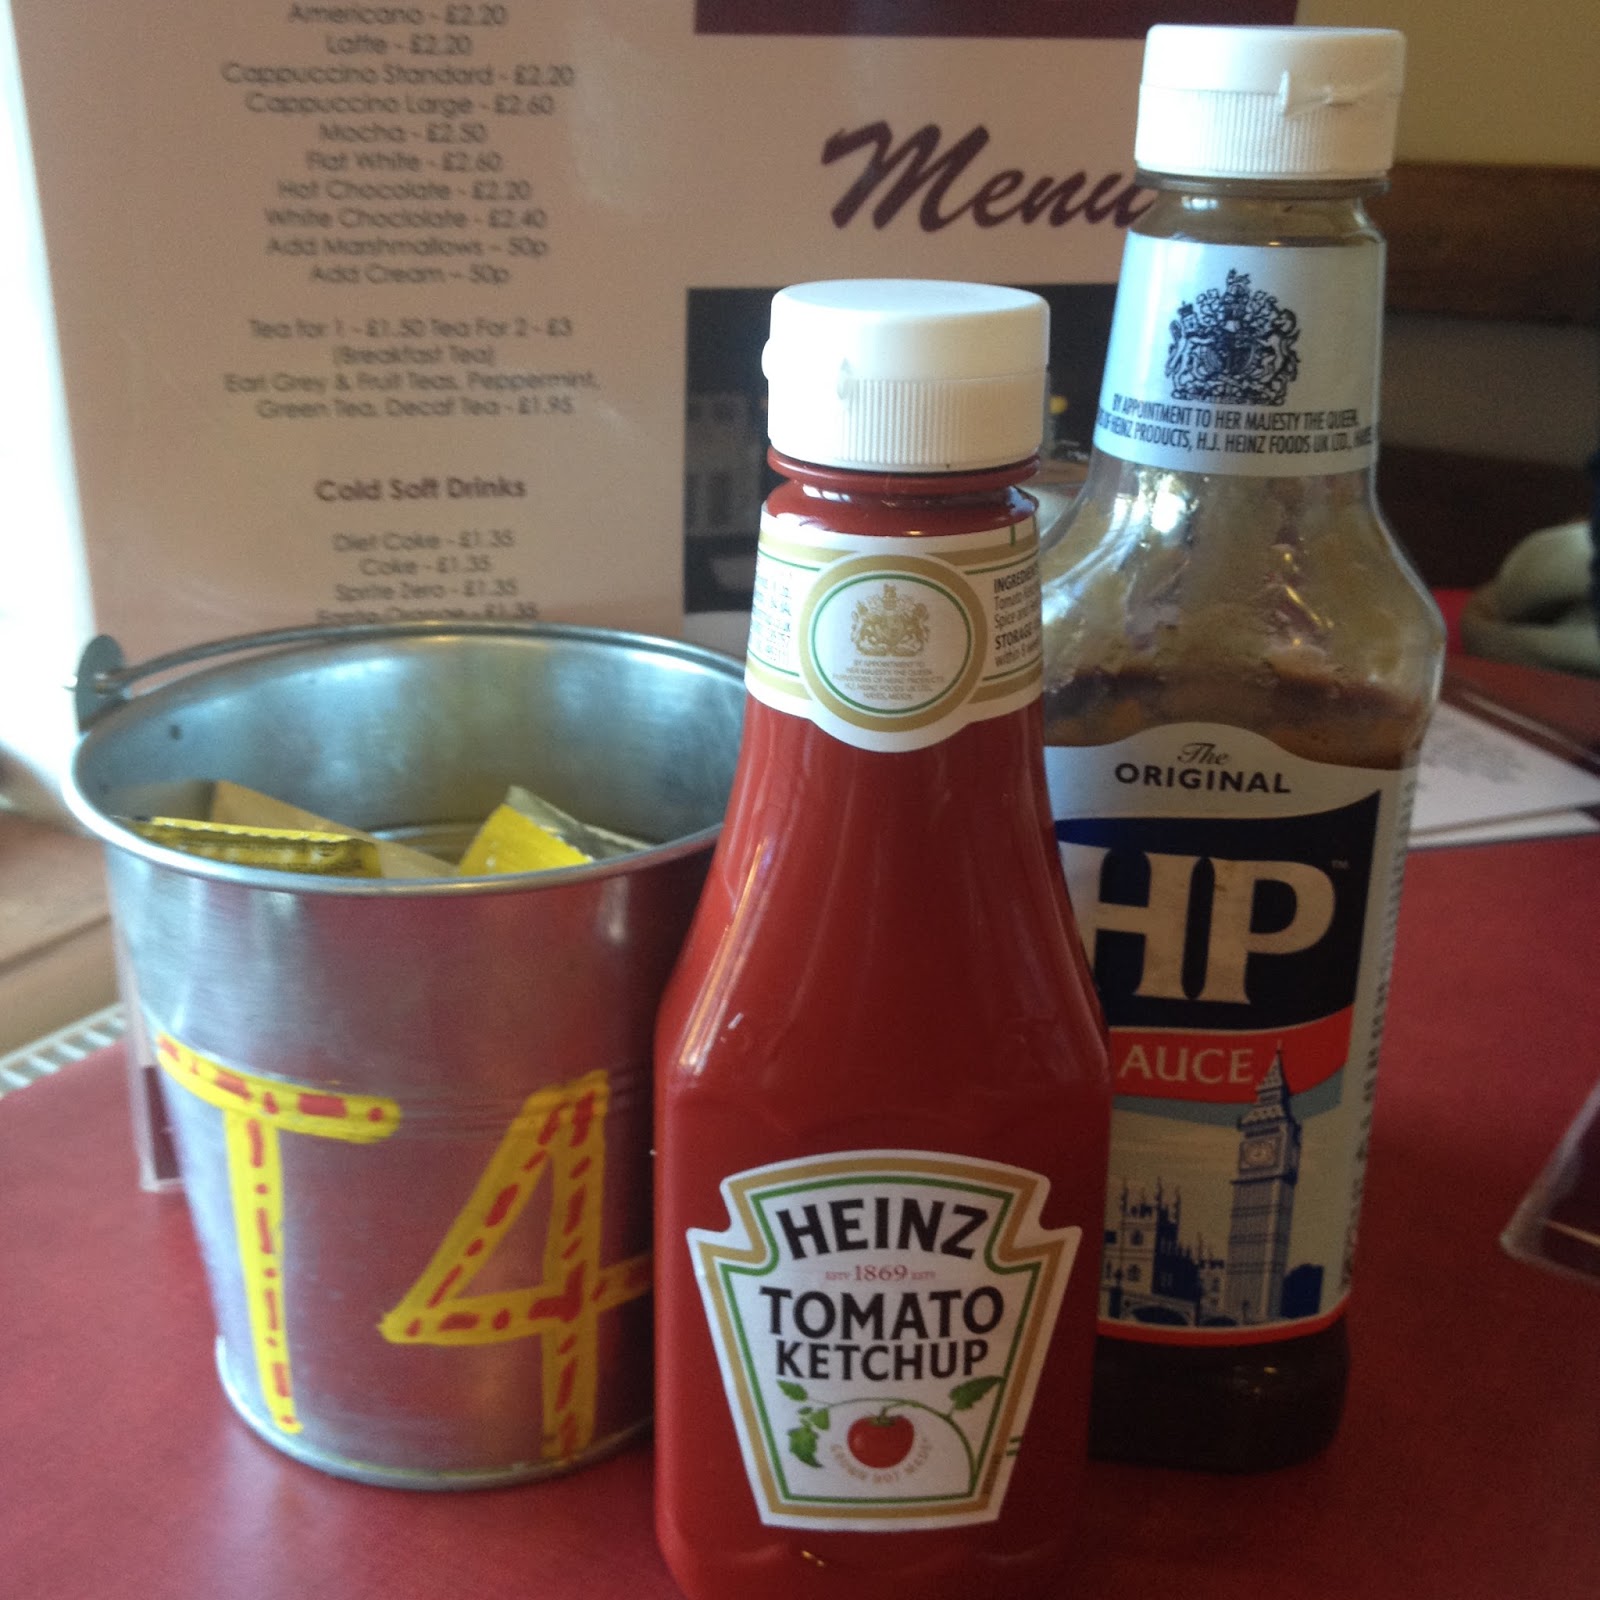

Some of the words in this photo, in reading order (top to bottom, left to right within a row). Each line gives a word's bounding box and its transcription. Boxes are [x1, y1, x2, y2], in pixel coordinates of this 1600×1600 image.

[288, 2, 424, 24] Americano
[444, 4, 508, 26] £2.20
[325, 33, 388, 55] Latte
[409, 33, 473, 56] £2.20
[221, 62, 378, 86] Cappuccino
[383, 62, 495, 86] Standard
[514, 63, 575, 86] £2.20
[244, 92, 399, 116] Cappuccino
[405, 92, 474, 118] Large
[493, 93, 556, 116] £2.60
[319, 122, 406, 143] Mocha
[426, 122, 488, 143] £2.50
[354, 151, 421, 172] White
[442, 151, 503, 172] £2.60
[821, 120, 1156, 232] Menu
[276, 179, 320, 200] Hot
[325, 179, 451, 201] Chocolate
[471, 179, 533, 201] £2.20
[263, 208, 333, 228] White
[487, 208, 548, 229] £2.40
[267, 237, 318, 257] Add
[322, 237, 483, 257] Marshmallows
[507, 237, 550, 259] 50p
[309, 265, 360, 284] Add
[364, 264, 446, 284] Cream
[248, 319, 292, 338] Tea
[430, 318, 471, 338] Tea
[224, 373, 267, 393] Earl
[271, 373, 327, 395] Grey
[335, 373, 351, 391] &
[356, 372, 402, 391] Fruit
[256, 399, 328, 418] Green
[385, 397, 455, 417] Decaf
[460, 397, 501, 416] Tea
[1122, 396, 1193, 426] APPOINTMENT
[1195, 408, 1211, 428] TO
[1215, 410, 1242, 430] HER
[1243, 412, 1301, 431] MAJESTY
[1303, 411, 1325, 430] THE
[1110, 415, 1133, 438] HEINZ
[1224, 434, 1267, 454] HEINZ
[1269, 435, 1311, 454] FOODS
[314, 477, 382, 501] Cold
[388, 476, 440, 500] Soft
[446, 476, 528, 499] Drinks
[332, 531, 378, 551] Diet
[382, 531, 441, 551] Coke
[358, 557, 419, 576] Coke
[1177, 742, 1230, 765] The
[1115, 763, 1292, 794] ORIGINAL
[1057, 841, 1336, 1005] HP
[1117, 1044, 1255, 1084] AUCE
[776, 1197, 989, 1260] HEINZ
[854, 1264, 908, 1281] 1869
[759, 1286, 1005, 1340] TOMATO
[776, 1340, 989, 1381] KETCHUP
